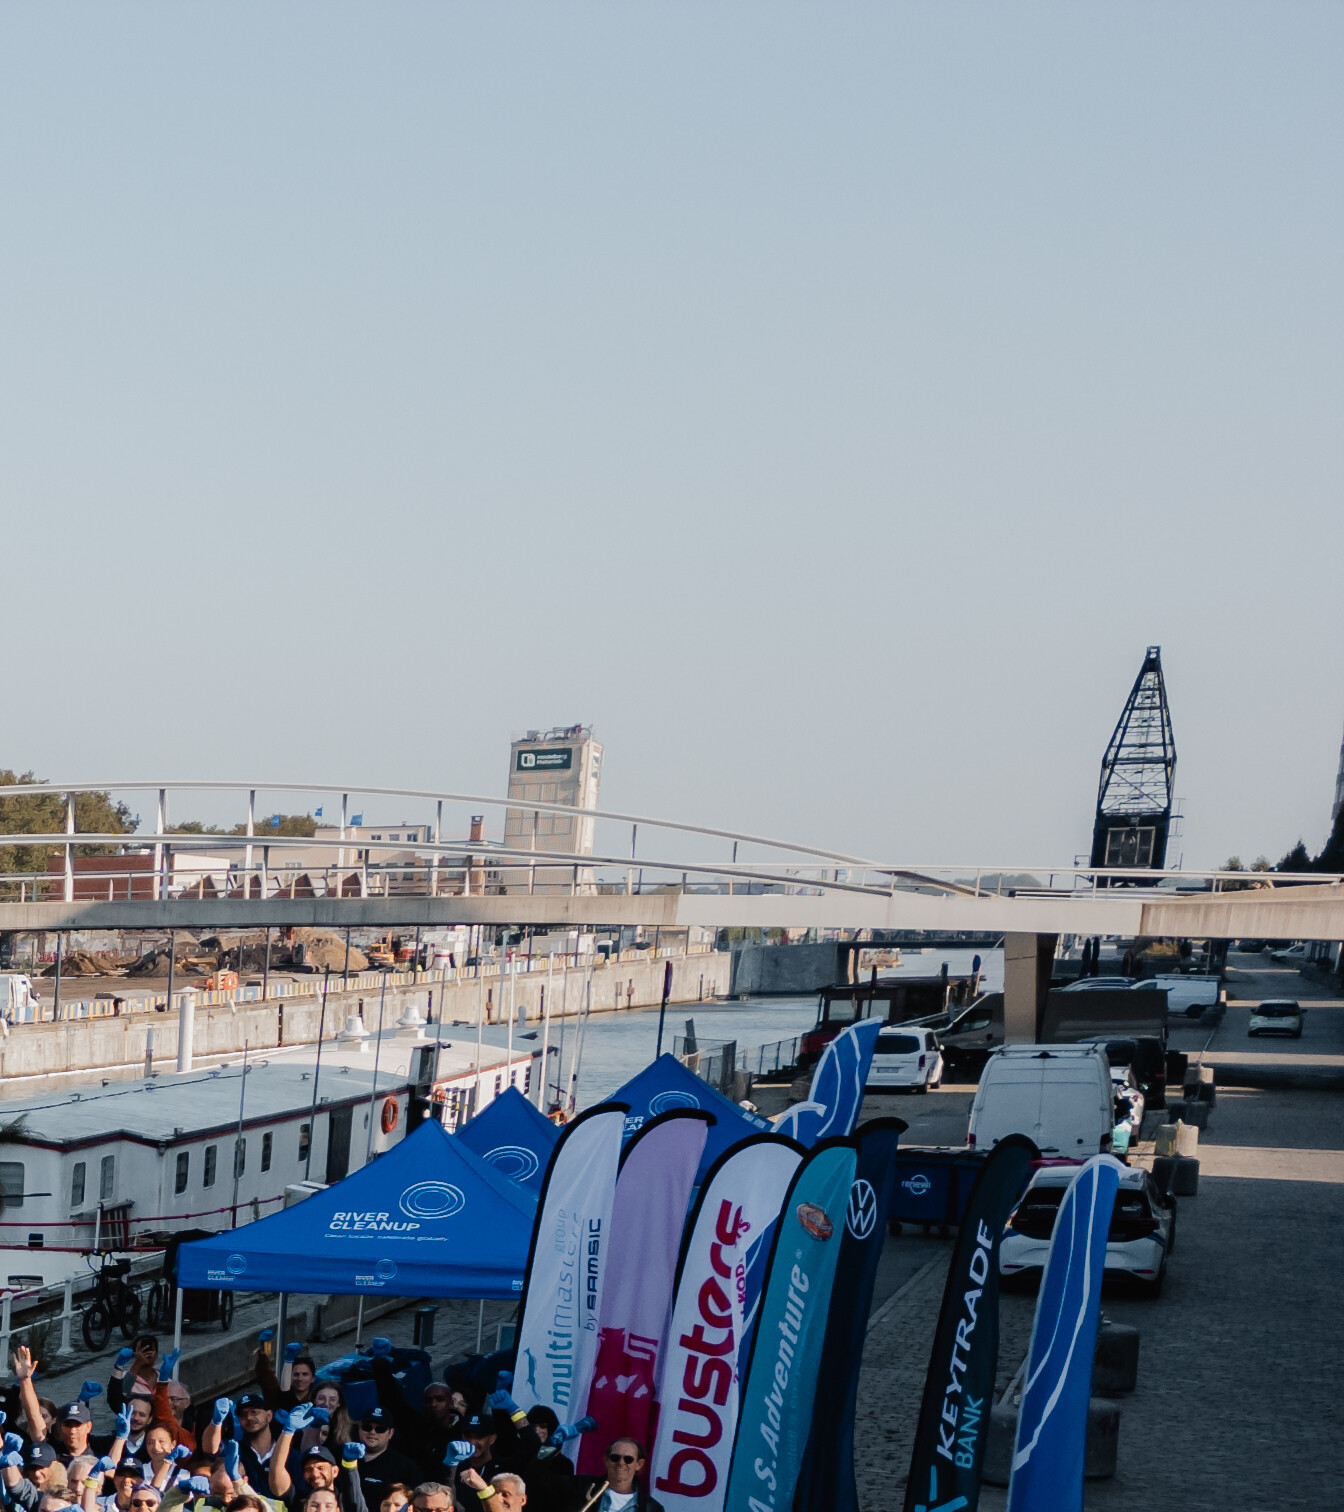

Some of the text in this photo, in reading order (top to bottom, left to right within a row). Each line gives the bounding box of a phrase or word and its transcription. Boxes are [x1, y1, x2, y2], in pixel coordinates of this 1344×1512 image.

[329, 1221, 421, 1231] CLEANUP
[332, 1212, 390, 1221] RIVER
[584, 1218, 602, 1331] by SAMSIC
[936, 1218, 994, 1461] KEYTRADE
[955, 1394, 984, 1469] BANK
